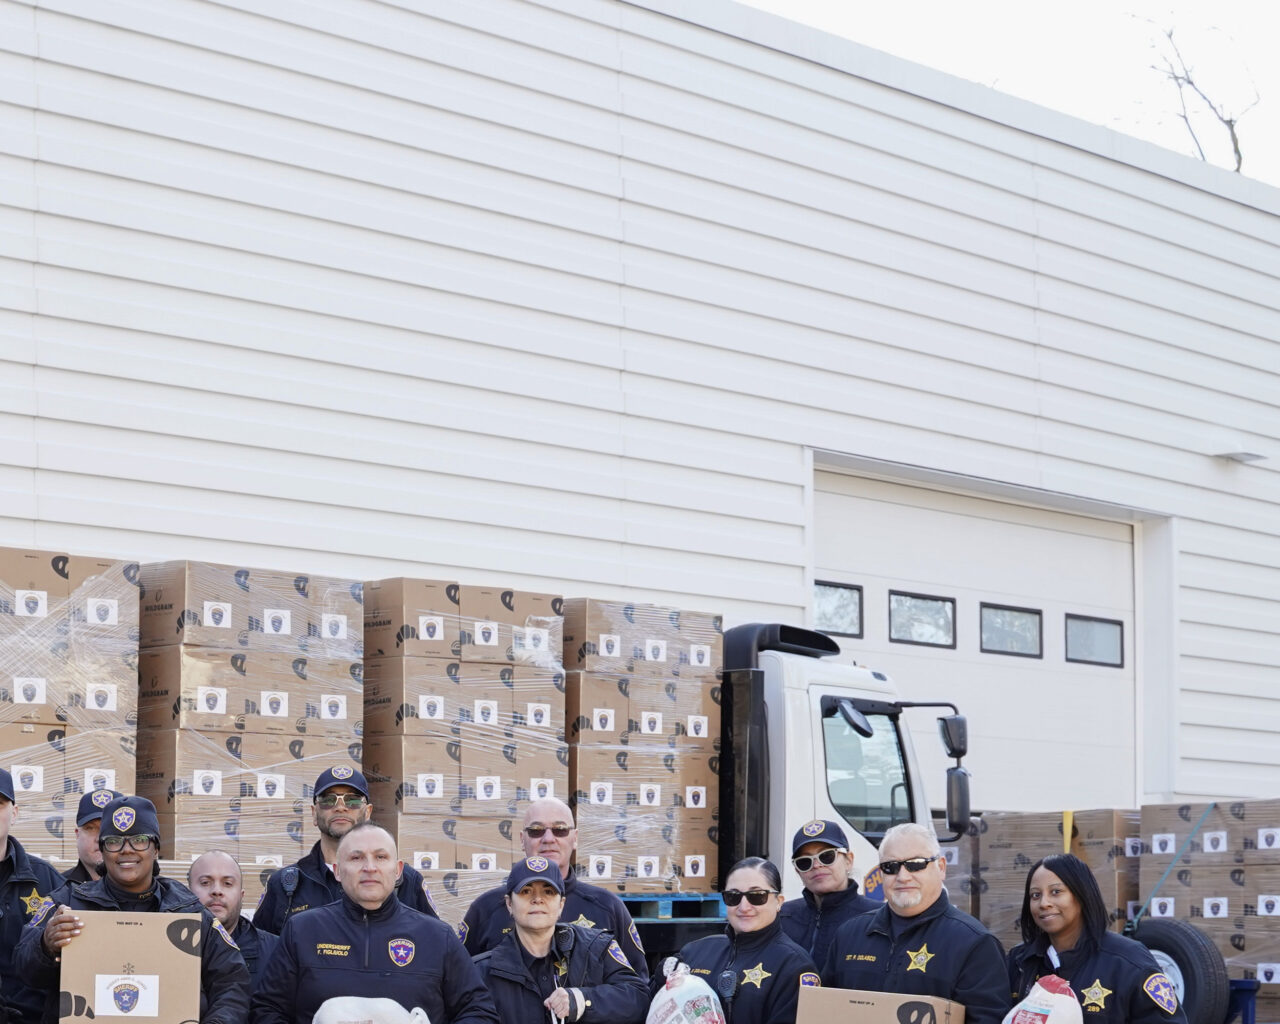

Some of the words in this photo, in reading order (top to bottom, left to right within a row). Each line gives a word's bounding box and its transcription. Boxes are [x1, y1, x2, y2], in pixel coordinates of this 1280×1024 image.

[144, 603, 174, 612] WILDGRAIN
[316, 943, 351, 951] UNDERSHERIFF
[114, 984, 139, 993] SHERIFF
[1087, 1005, 1100, 1013] 289
